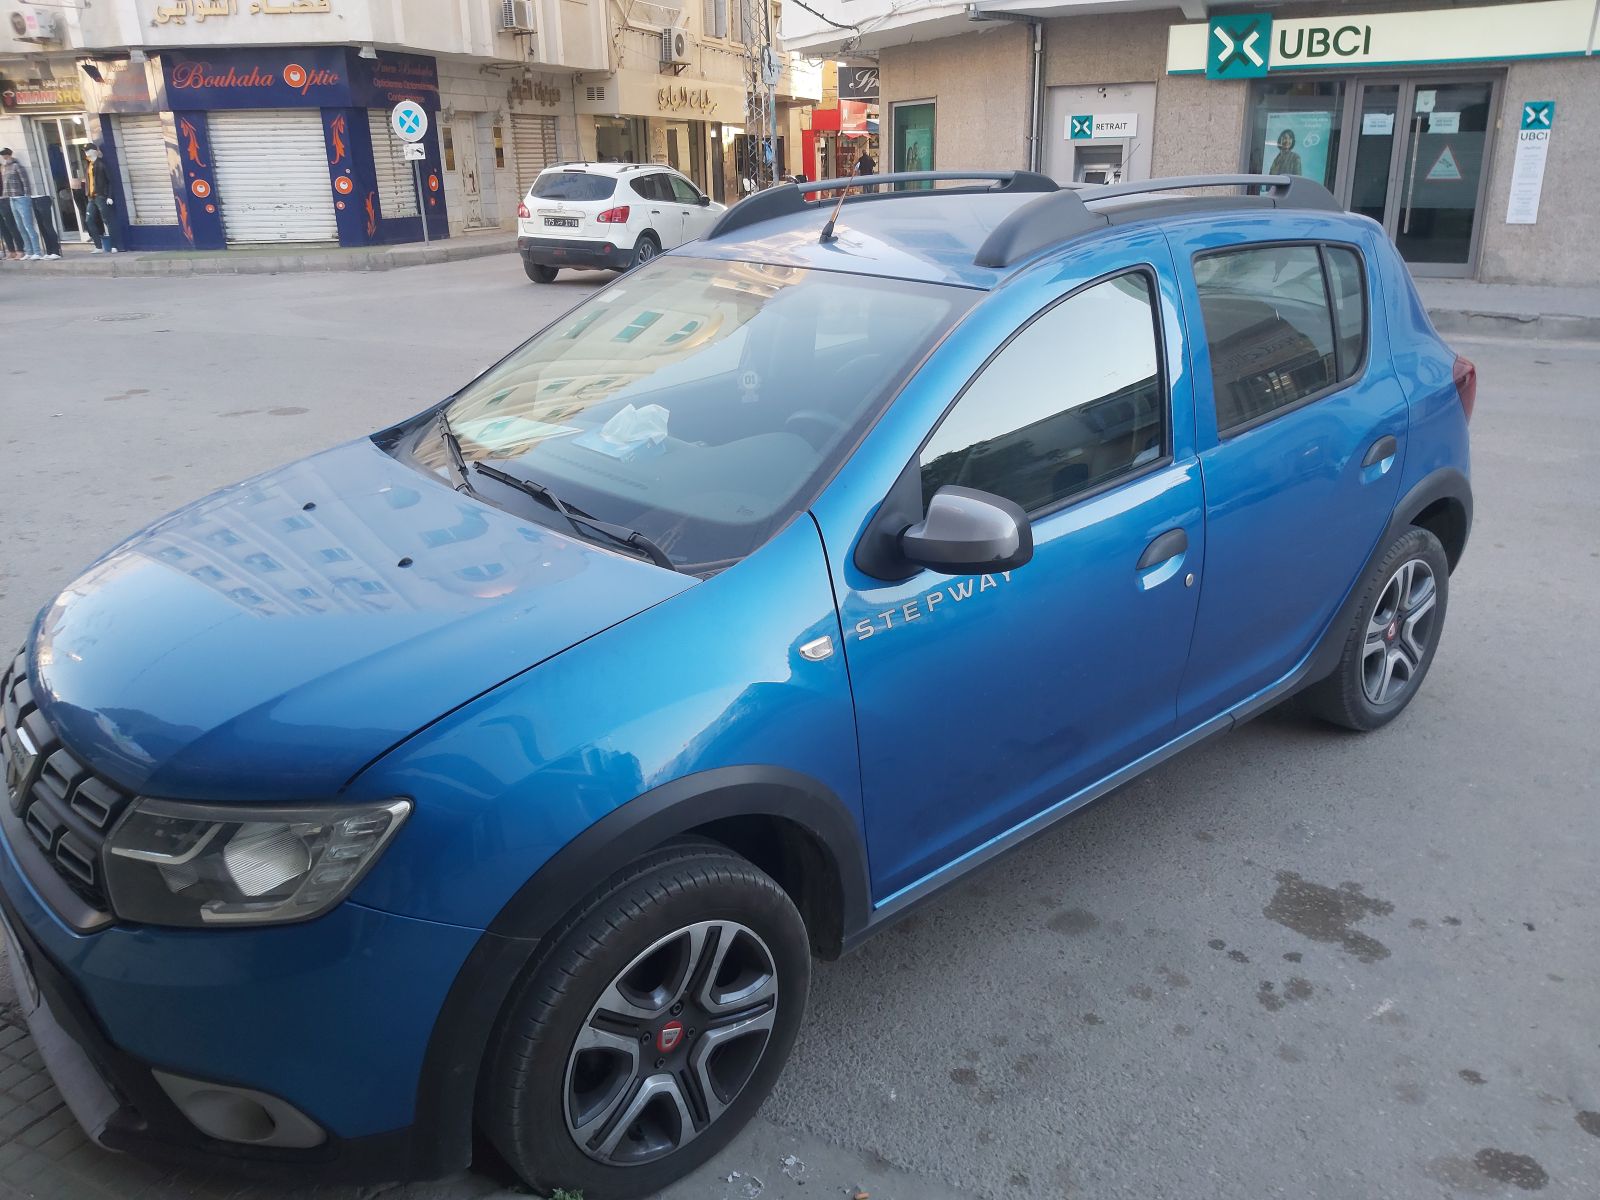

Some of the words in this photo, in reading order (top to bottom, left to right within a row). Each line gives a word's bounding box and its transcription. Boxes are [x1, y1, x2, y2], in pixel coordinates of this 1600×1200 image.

[1279, 25, 1372, 59] UBCI
[172, 61, 276, 89] Bouhaha
[283, 63, 340, 96] Optic
[56, 88, 83, 104] SHO
[1095, 122, 1128, 131] RETRAIT
[1520, 132, 1548, 141] UBCI
[855, 570, 1012, 641] STEPWAY
